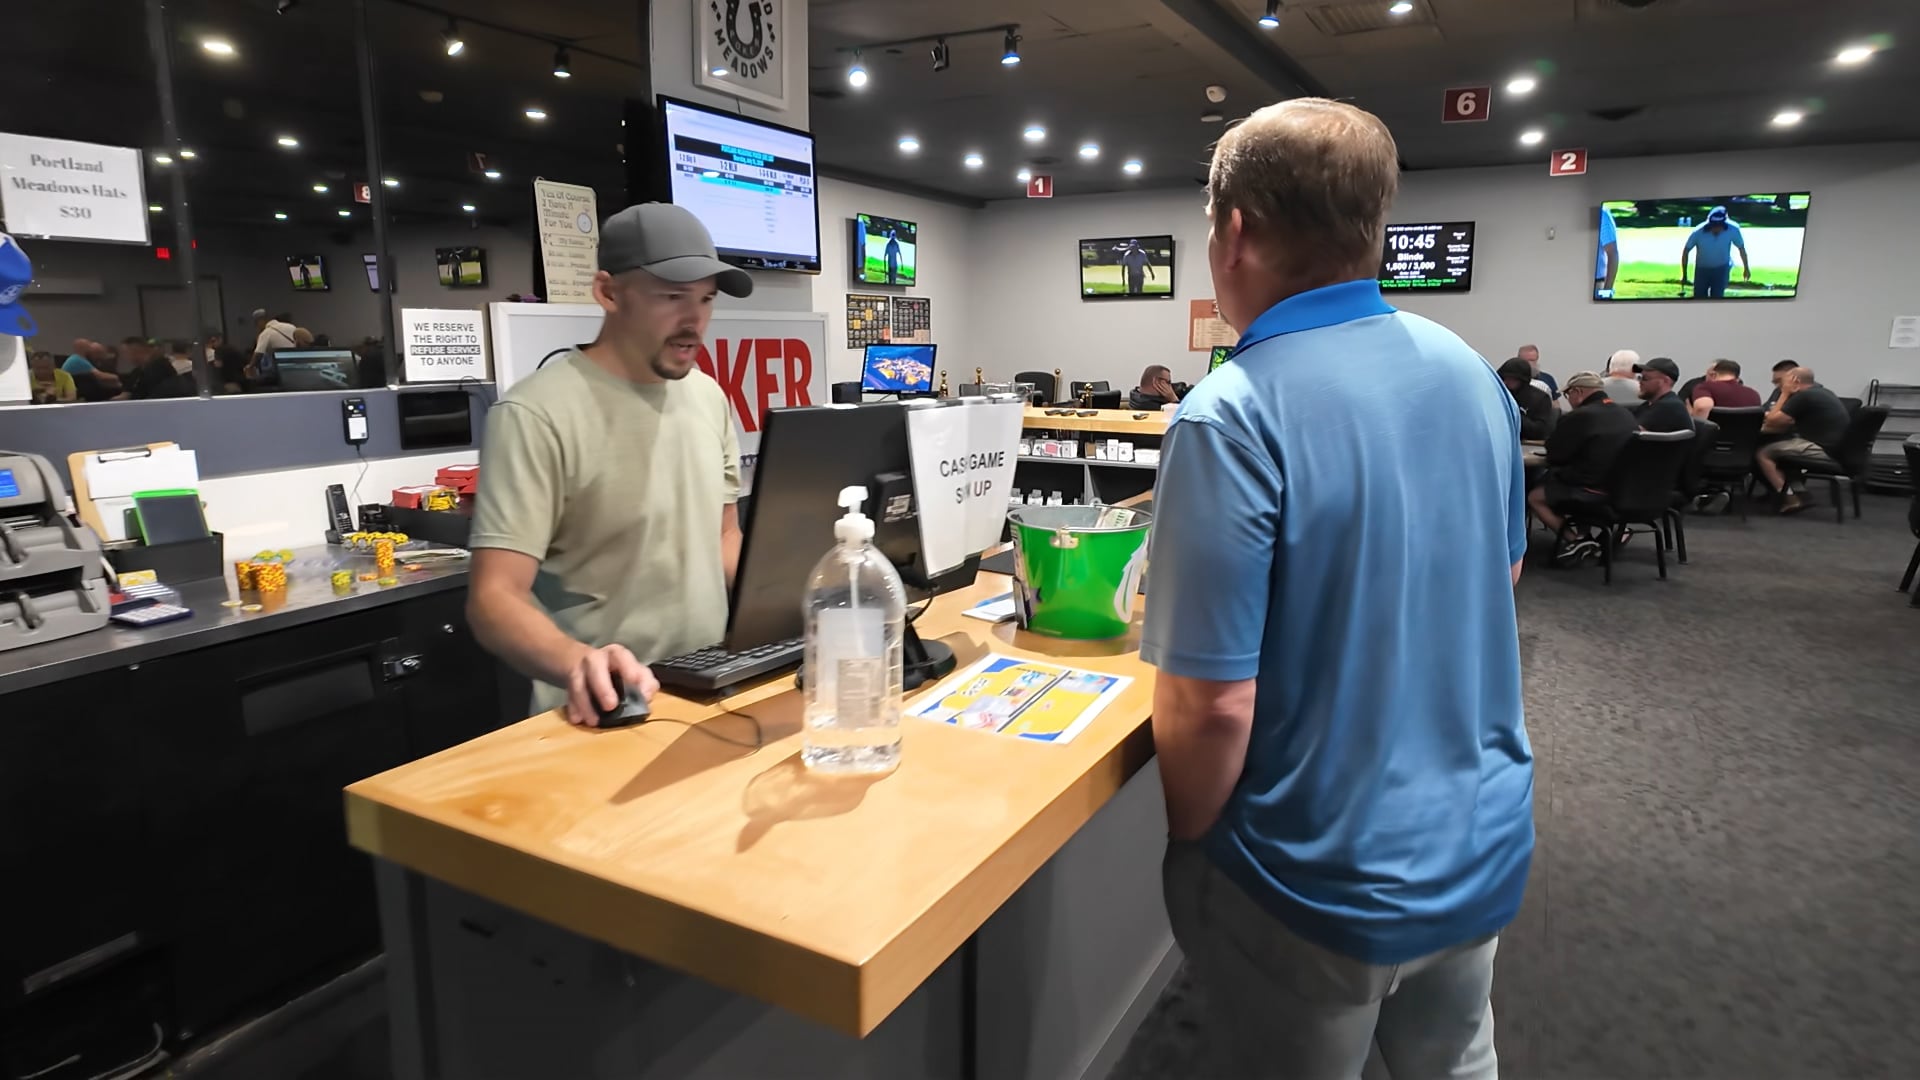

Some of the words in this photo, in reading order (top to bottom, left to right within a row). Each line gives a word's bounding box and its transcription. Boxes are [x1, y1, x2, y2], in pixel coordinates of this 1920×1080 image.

[714, 28, 774, 79] MEADOWS
[1456, 91, 1476, 116] 6
[30, 153, 104, 173] Portland
[1560, 152, 1577, 171] 2
[11, 176, 89, 194] Meadows
[92, 184, 127, 198] Hats
[1034, 177, 1044, 194] 1
[59, 206, 92, 219] $30
[1389, 233, 1436, 250] 10:45
[1397, 252, 1424, 261] Blinds
[413, 322, 430, 332] WE
[432, 322, 475, 332] RESERVE
[413, 334, 433, 344] THE
[435, 334, 463, 344] RIGHT
[465, 334, 478, 344] TO
[411, 345, 445, 354] REFUSE
[446, 345, 480, 354] SERVICE
[420, 356, 434, 366] TO
[436, 356, 475, 366] ANYONE
[939, 456, 968, 477] CAS
[969, 451, 1005, 470] GAME
[973, 479, 992, 498] UP
